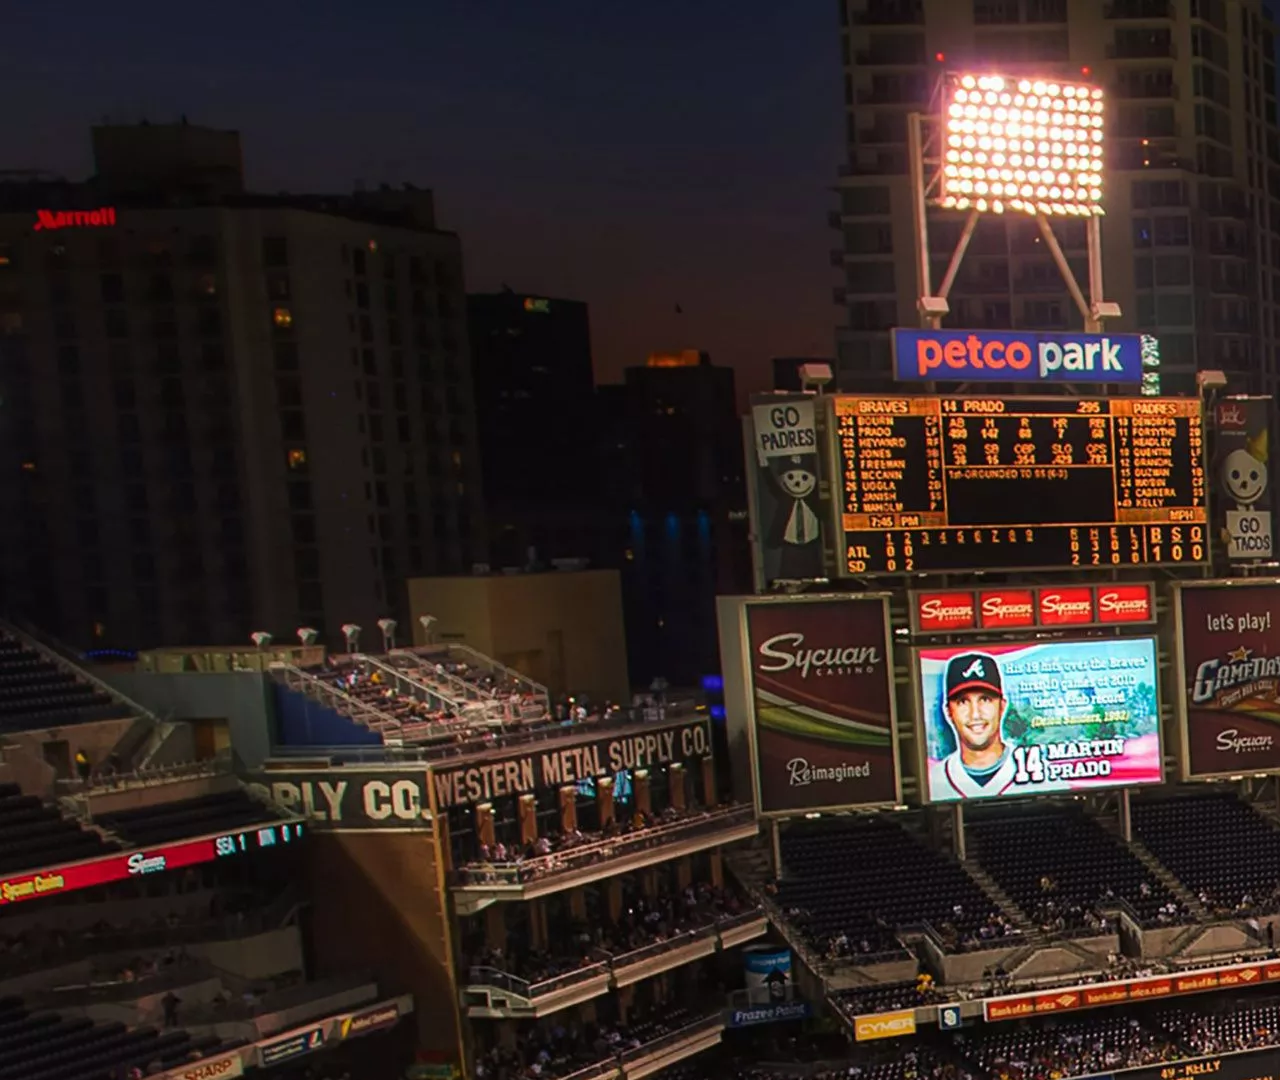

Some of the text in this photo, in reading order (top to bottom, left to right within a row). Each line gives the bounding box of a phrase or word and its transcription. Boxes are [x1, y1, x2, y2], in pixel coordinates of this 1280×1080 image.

[33, 207, 115, 230] Marriott
[917, 335, 1031, 376] petco
[1038, 338, 1122, 378] park
[859, 401, 908, 413] BRAVES
[943, 401, 957, 412] 14
[964, 401, 1004, 412] PRADO
[1133, 402, 1176, 415] PADRES
[771, 406, 800, 429] GO
[761, 428, 814, 450] PADRES
[858, 427, 891, 437] PRADO
[858, 438, 906, 448] HEYWARD
[1013, 444, 1035, 454] OBP
[859, 449, 892, 459] JONES
[862, 481, 896, 491] UGGLA
[1136, 488, 1176, 498] CABRERA
[1136, 499, 1164, 507] KELLY
[901, 515, 919, 526] PM
[1170, 510, 1194, 520] MPH
[1240, 518, 1260, 533] GO
[848, 545, 912, 558] ATL 0 0
[1233, 535, 1270, 551] TACOS
[1152, 544, 1202, 561] 1 0 0
[848, 553, 1099, 572] SD 0 2 2 2
[921, 599, 973, 621] Sycuan
[982, 598, 1033, 619] Sycuan
[1041, 595, 1091, 615] Sycuan
[1100, 593, 1148, 614] Sycuan
[1207, 611, 1271, 633] let's play!
[759, 633, 881, 678] Sycuan
[816, 666, 874, 676] CASINO
[1108, 675, 1136, 688] 2010
[1216, 729, 1274, 753] Sycuan
[435, 724, 710, 808] WESTERN METAL SUPPLY CO.
[1014, 739, 1124, 783] 14 MARTIN
[786, 757, 870, 787] Reimagined
[1049, 760, 1112, 780] PRADO
[364, 780, 433, 820] CO.
[216, 833, 246, 856] SEA 1
[735, 1003, 805, 1022] Frazee Paint
[991, 1005, 1011, 1017] Bank
[859, 1018, 913, 1035] CYMER
[1185, 1060, 1221, 1075] KELLY
